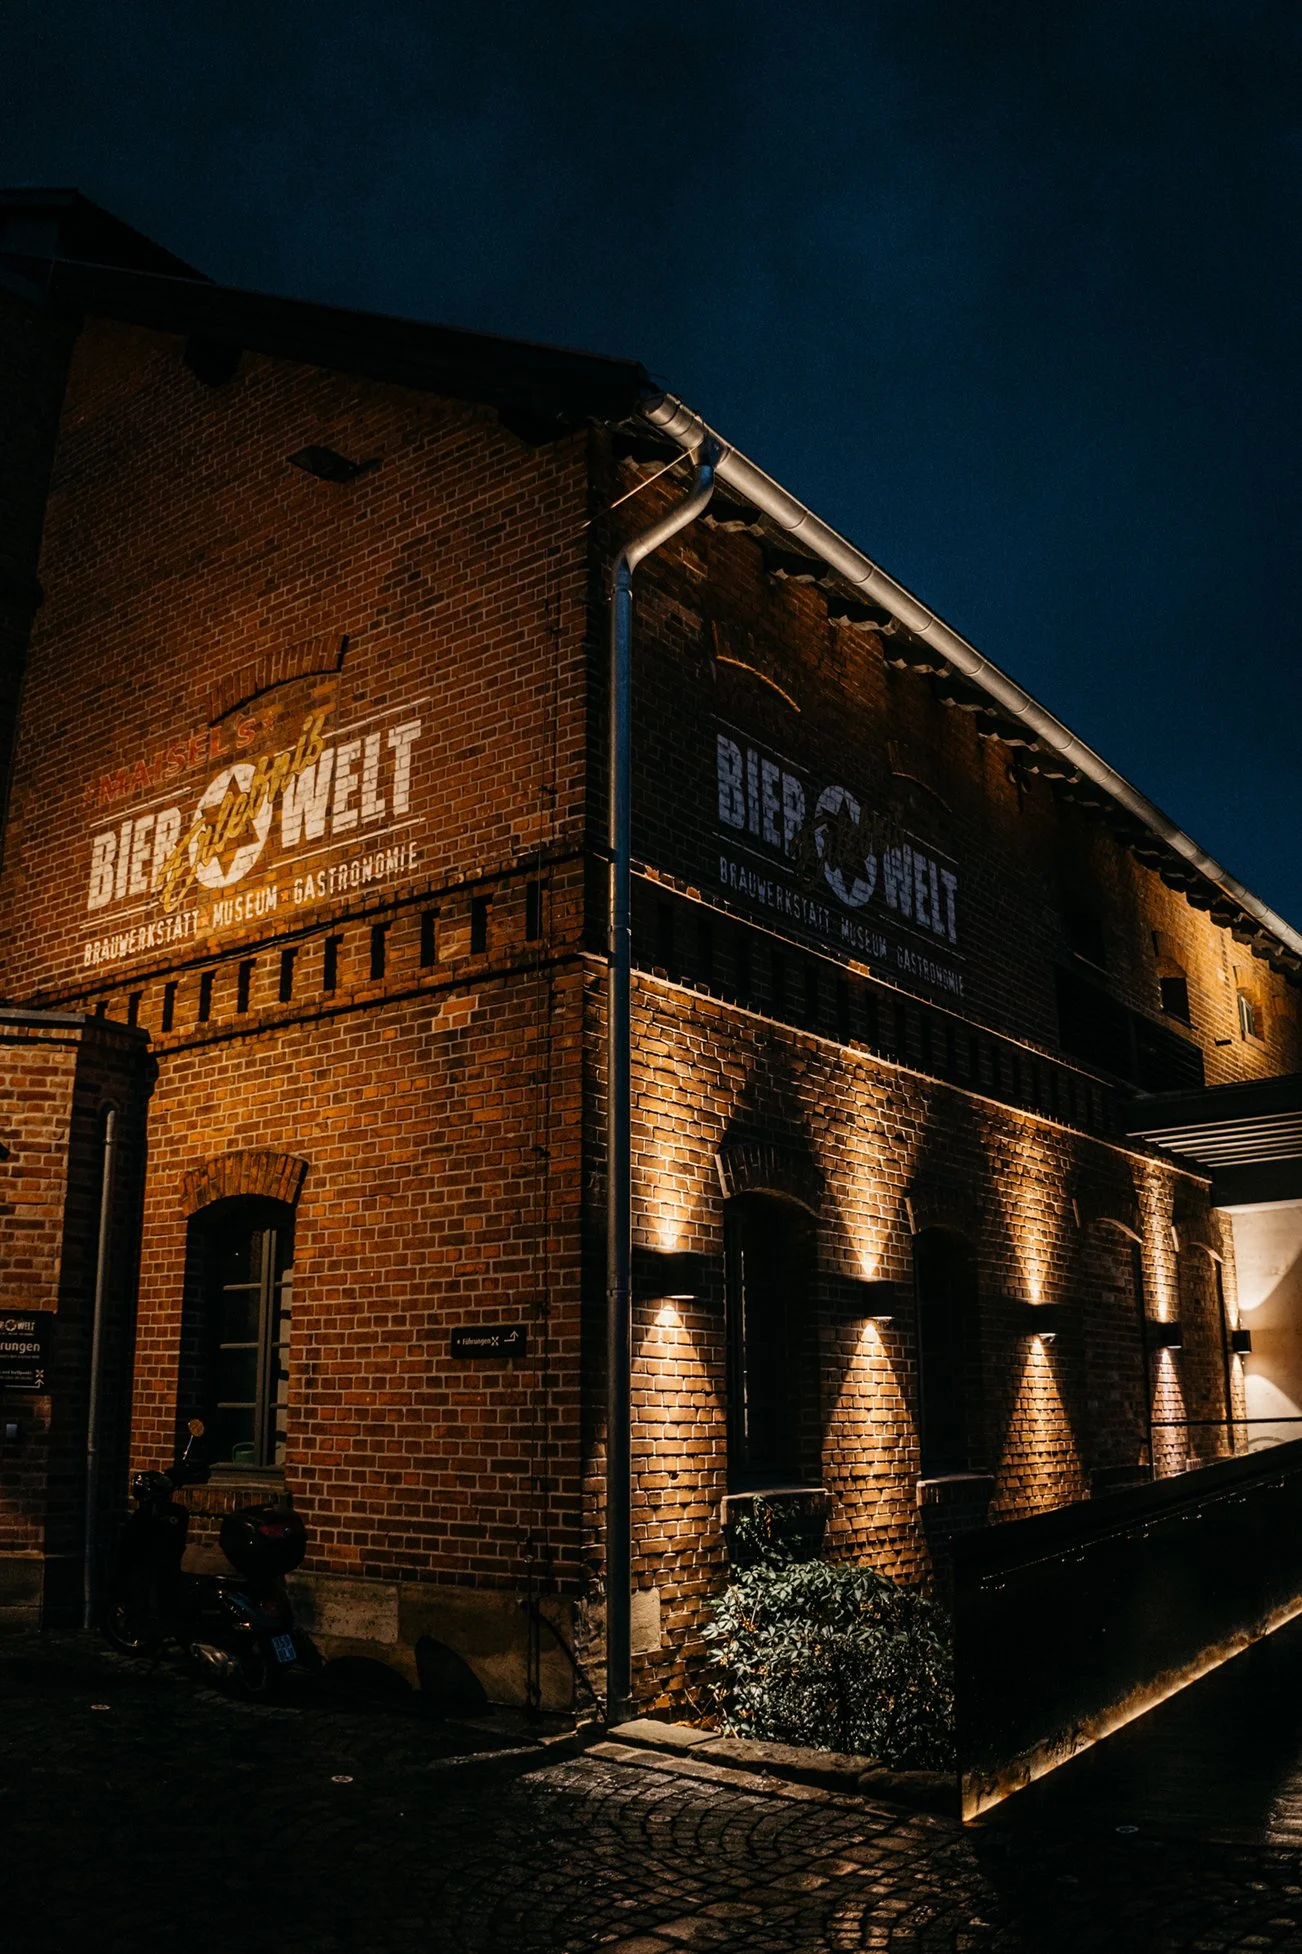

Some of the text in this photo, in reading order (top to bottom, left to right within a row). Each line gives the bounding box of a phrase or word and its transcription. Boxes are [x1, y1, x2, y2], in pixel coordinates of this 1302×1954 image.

[87, 807, 182, 911] BIER
[281, 719, 421, 849] WELT
[716, 733, 806, 861] BIER
[882, 843, 959, 946] WELT
[83, 841, 419, 967] BRAUWERKSTATT MUSEUM GASTRONOMIE
[719, 856, 965, 998] BRAUWERKSTATT MUSEUM GASTRONOMIE
